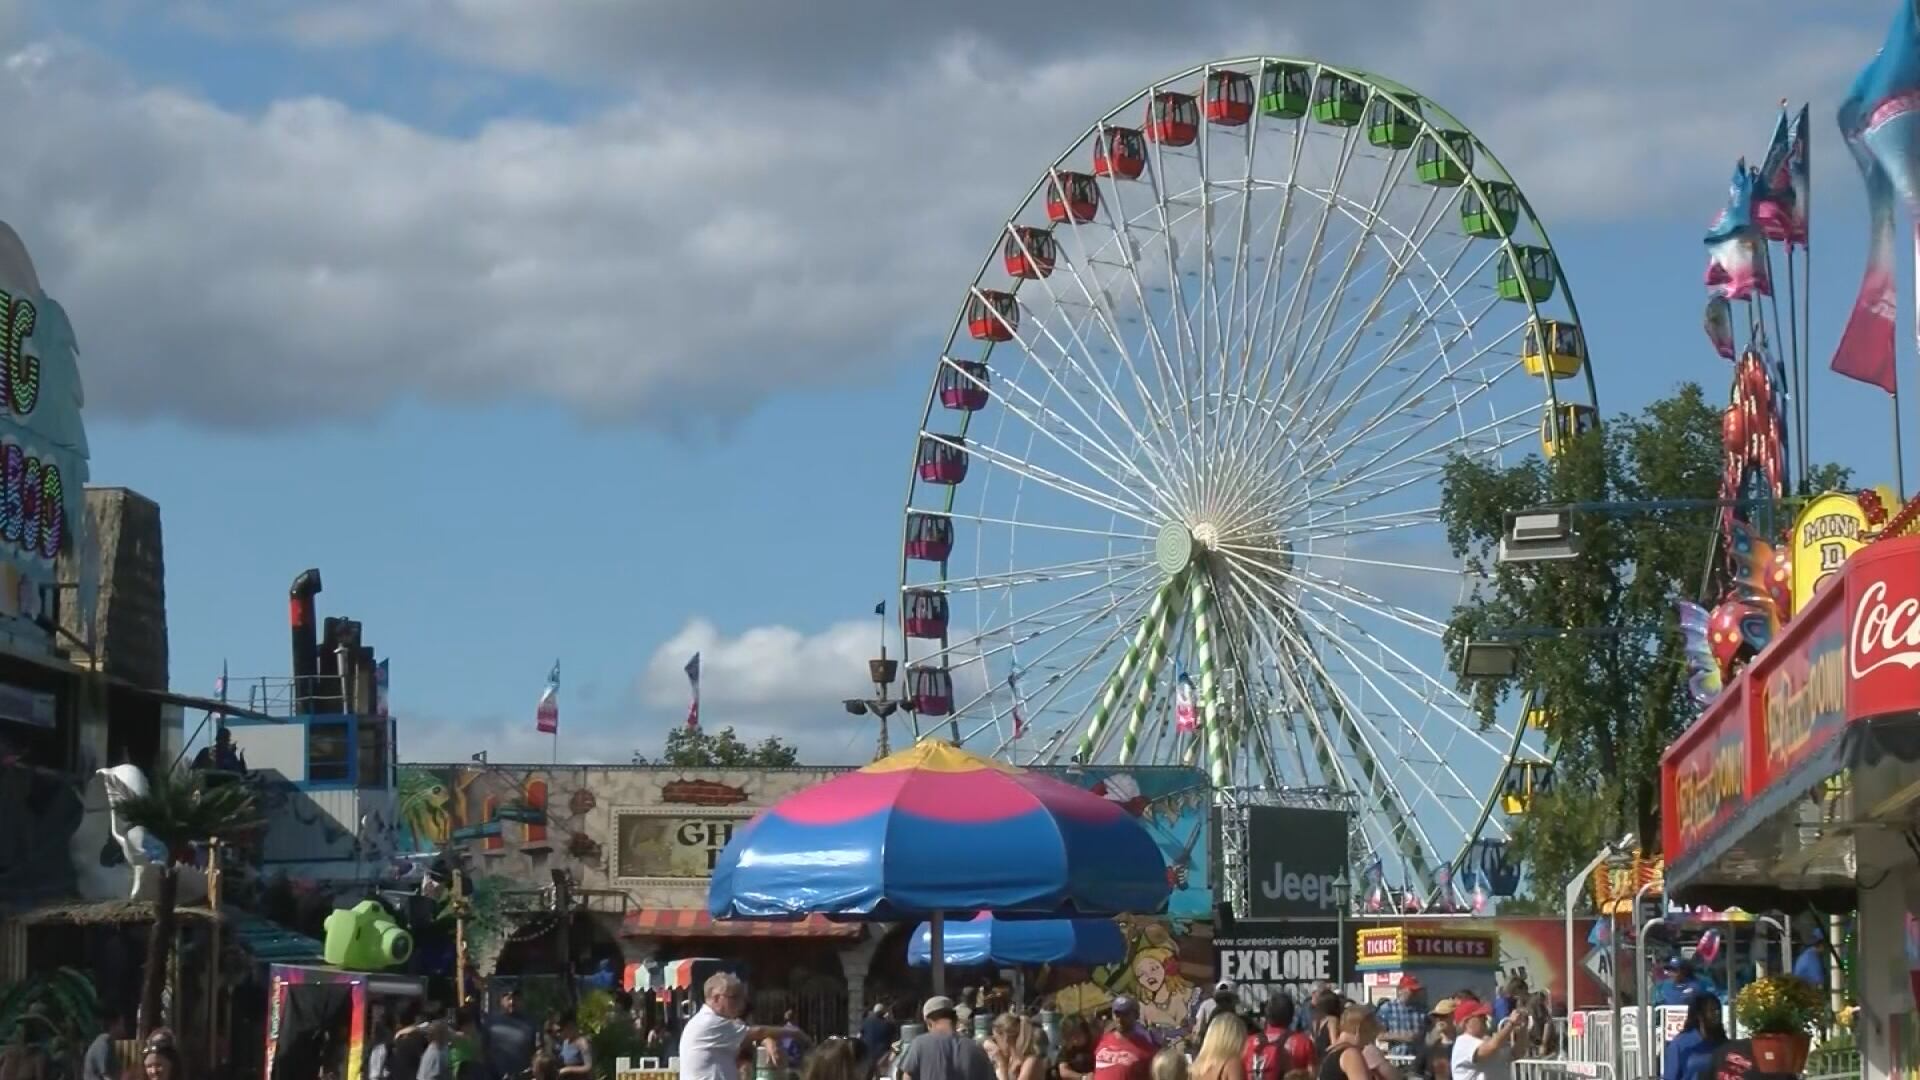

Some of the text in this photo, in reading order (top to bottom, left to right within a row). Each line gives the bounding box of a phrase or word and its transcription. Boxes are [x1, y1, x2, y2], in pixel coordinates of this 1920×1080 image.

[1804, 514, 1860, 548] MINI
[677, 822, 733, 846] GH
[1262, 861, 1338, 910] Jeep
[1212, 936, 1341, 947] www.careersinwelding.com
[1367, 939, 1397, 955] TICKETS
[1415, 939, 1486, 955] TICKETS
[1221, 950, 1330, 980] EXPLORE
